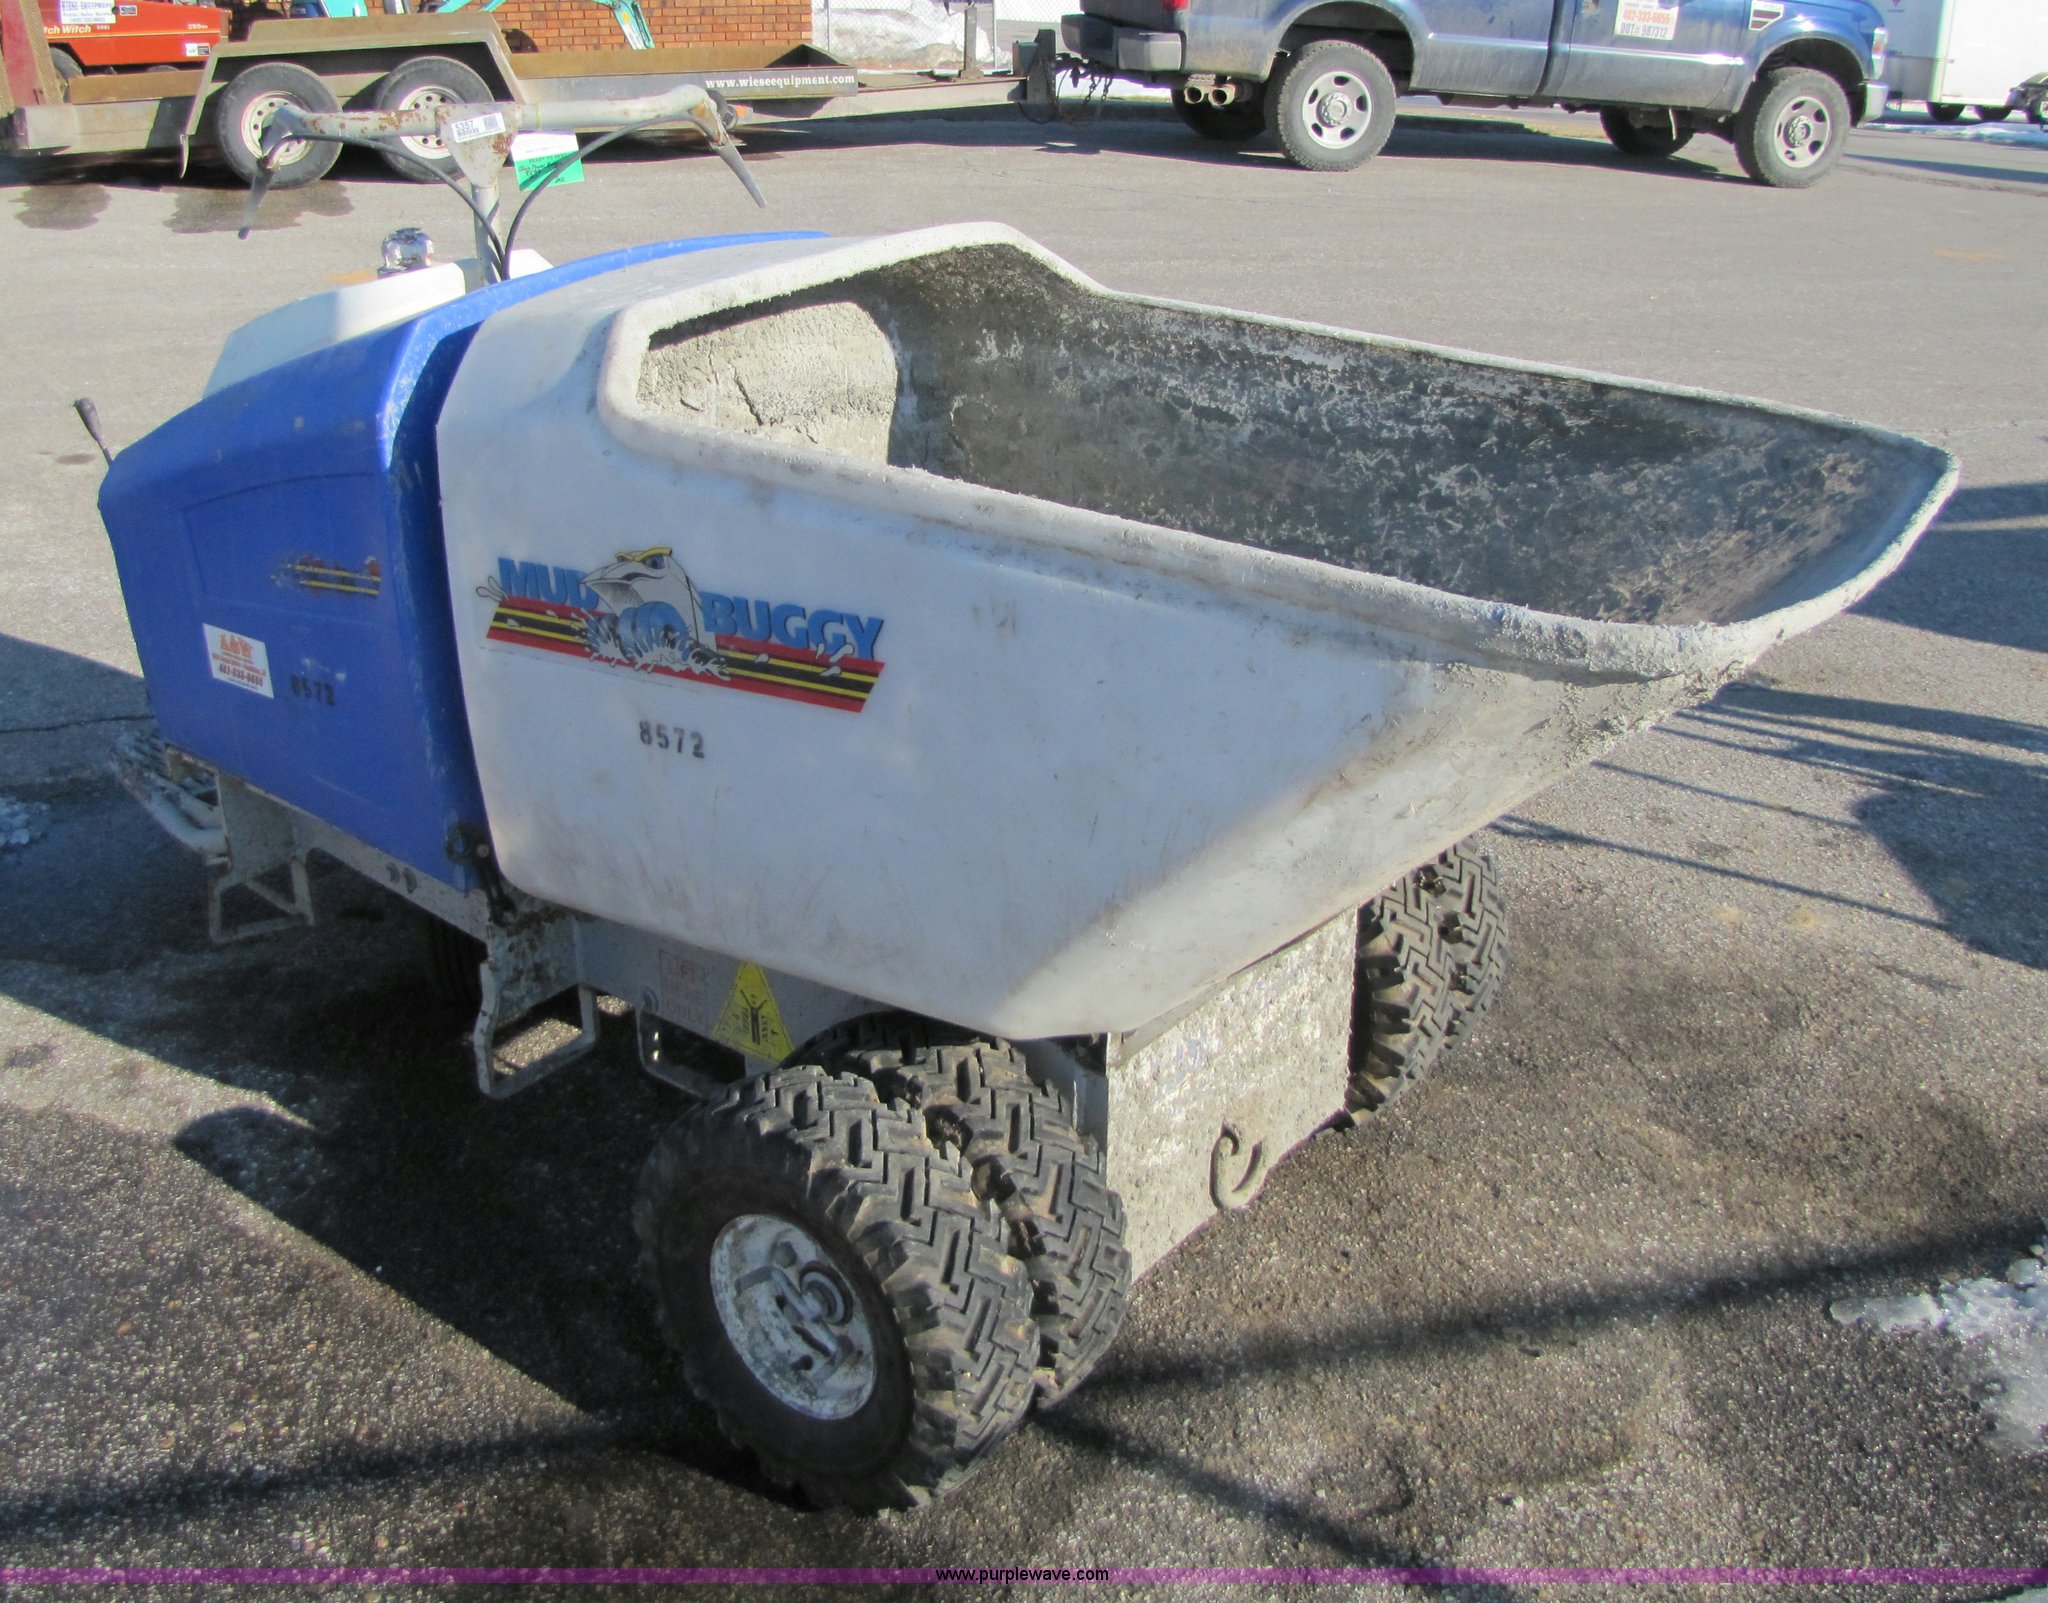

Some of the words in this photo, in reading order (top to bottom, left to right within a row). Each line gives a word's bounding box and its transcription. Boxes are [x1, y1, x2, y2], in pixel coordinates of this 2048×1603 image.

[62, 24, 91, 34] Witch
[705, 74, 855, 89] www.wieseequipment.com
[497, 556, 600, 611] MUD
[699, 590, 885, 660] BUGGY
[637, 717, 706, 760] 8572
